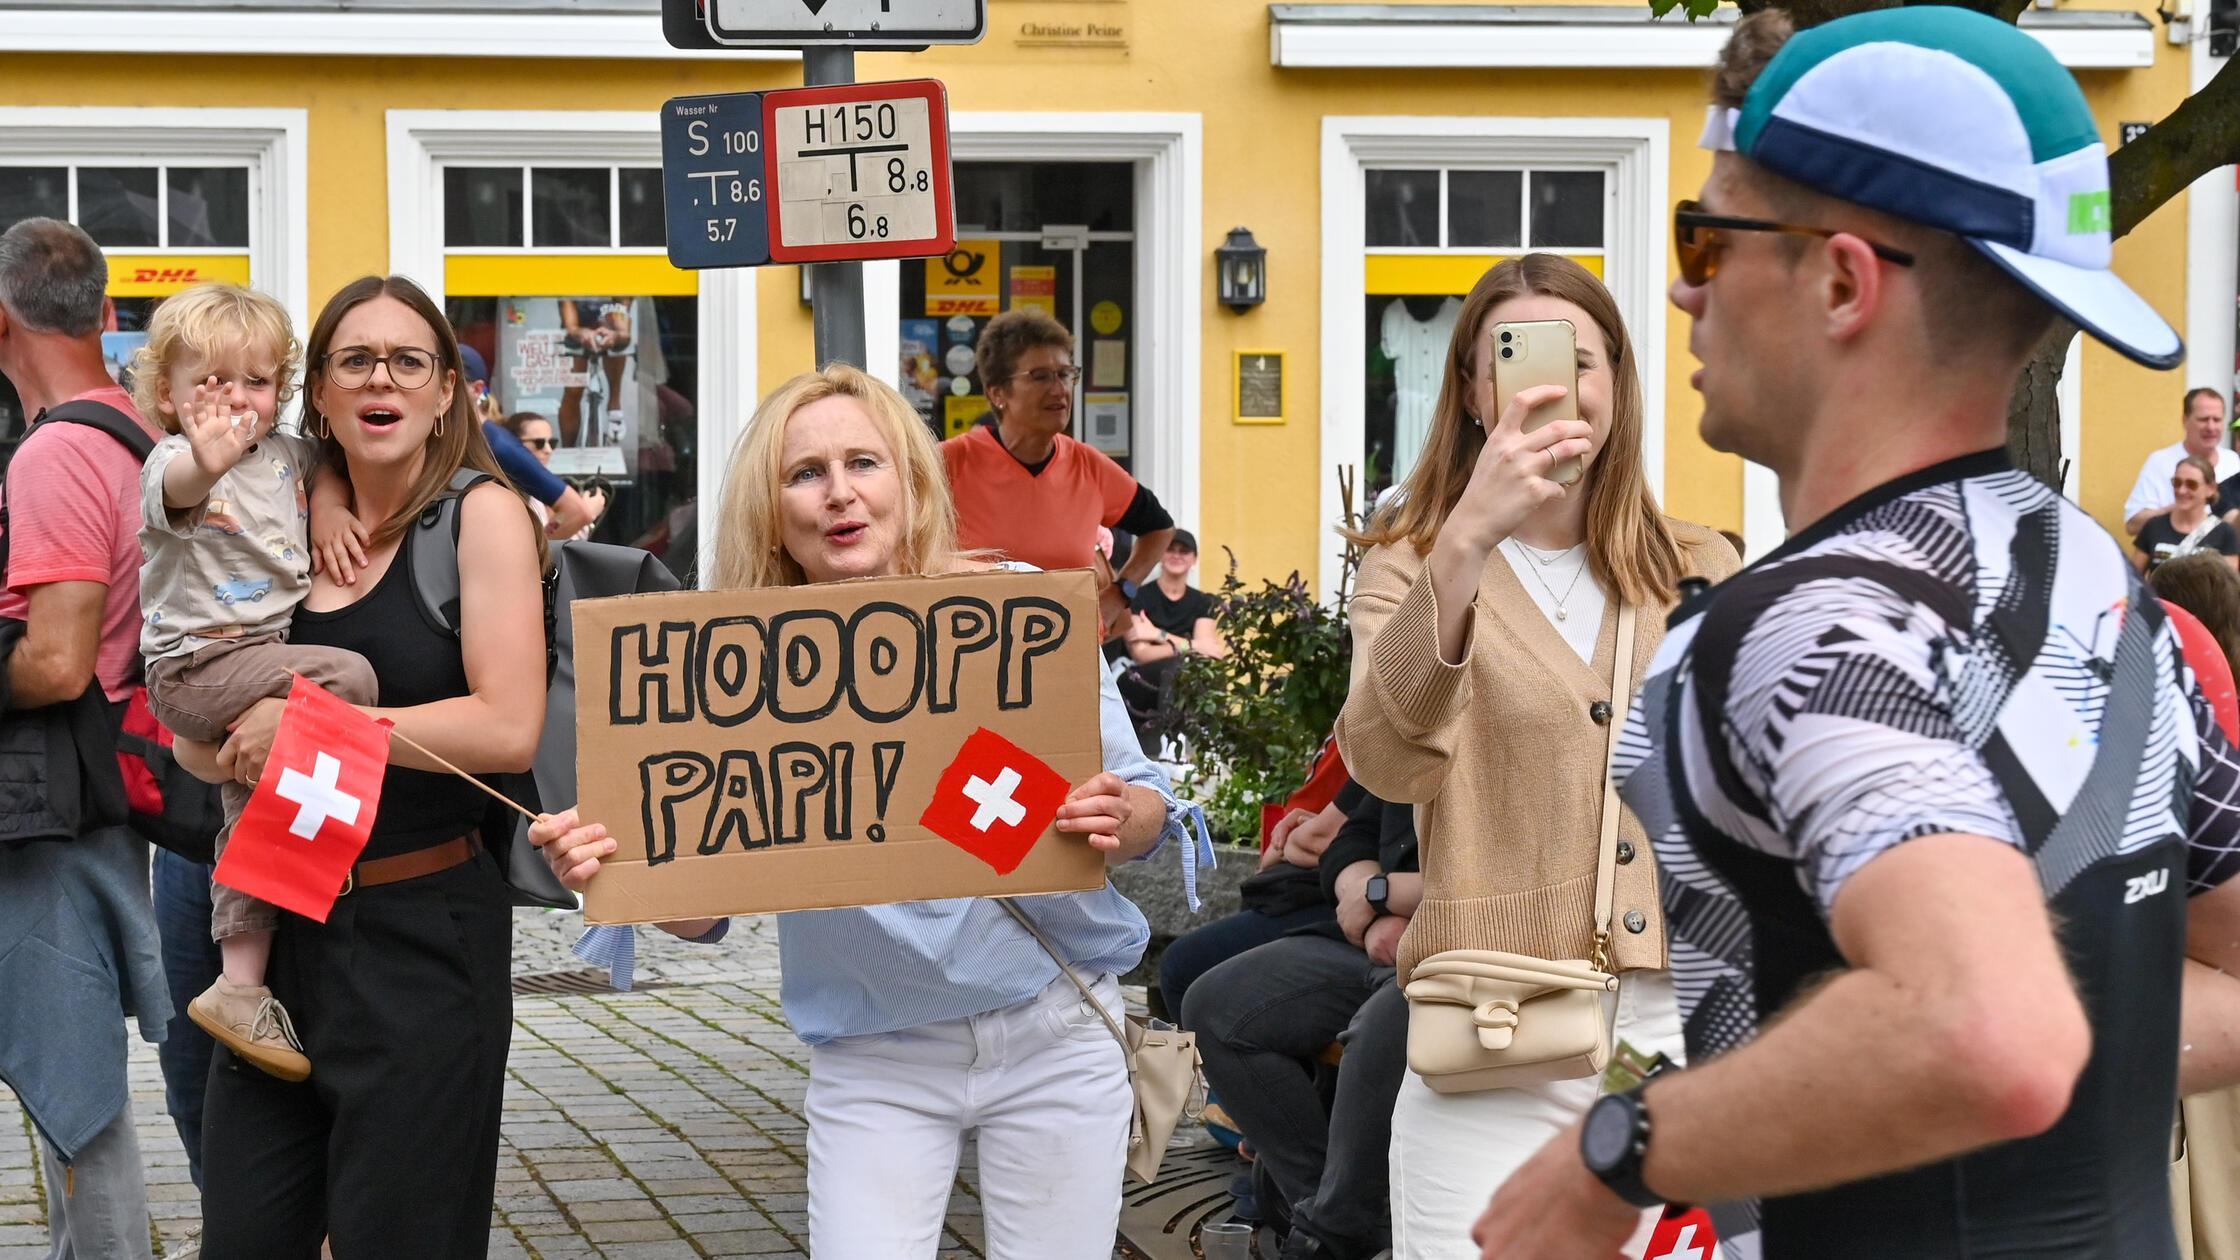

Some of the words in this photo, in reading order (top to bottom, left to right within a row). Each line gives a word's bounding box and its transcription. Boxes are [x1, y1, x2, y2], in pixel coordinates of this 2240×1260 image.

[1020, 22, 1081, 36] Christine
[1087, 22, 1123, 36] Peine
[676, 105, 706, 116] Wasser
[708, 104, 719, 114] Nr
[805, 103, 896, 144] H150
[688, 120, 710, 156] S
[722, 130, 759, 155] 100
[730, 179, 761, 204] 8,6
[887, 157, 929, 193] 8,8
[706, 218, 737, 243] 5,7
[847, 203, 889, 239] 6,8
[133, 269, 198, 283] DHL
[937, 300, 988, 313] DHL
[609, 596, 1071, 728] HOOOPP
[638, 740, 906, 867] PAPI!
[2123, 867, 2170, 905] 2XU
